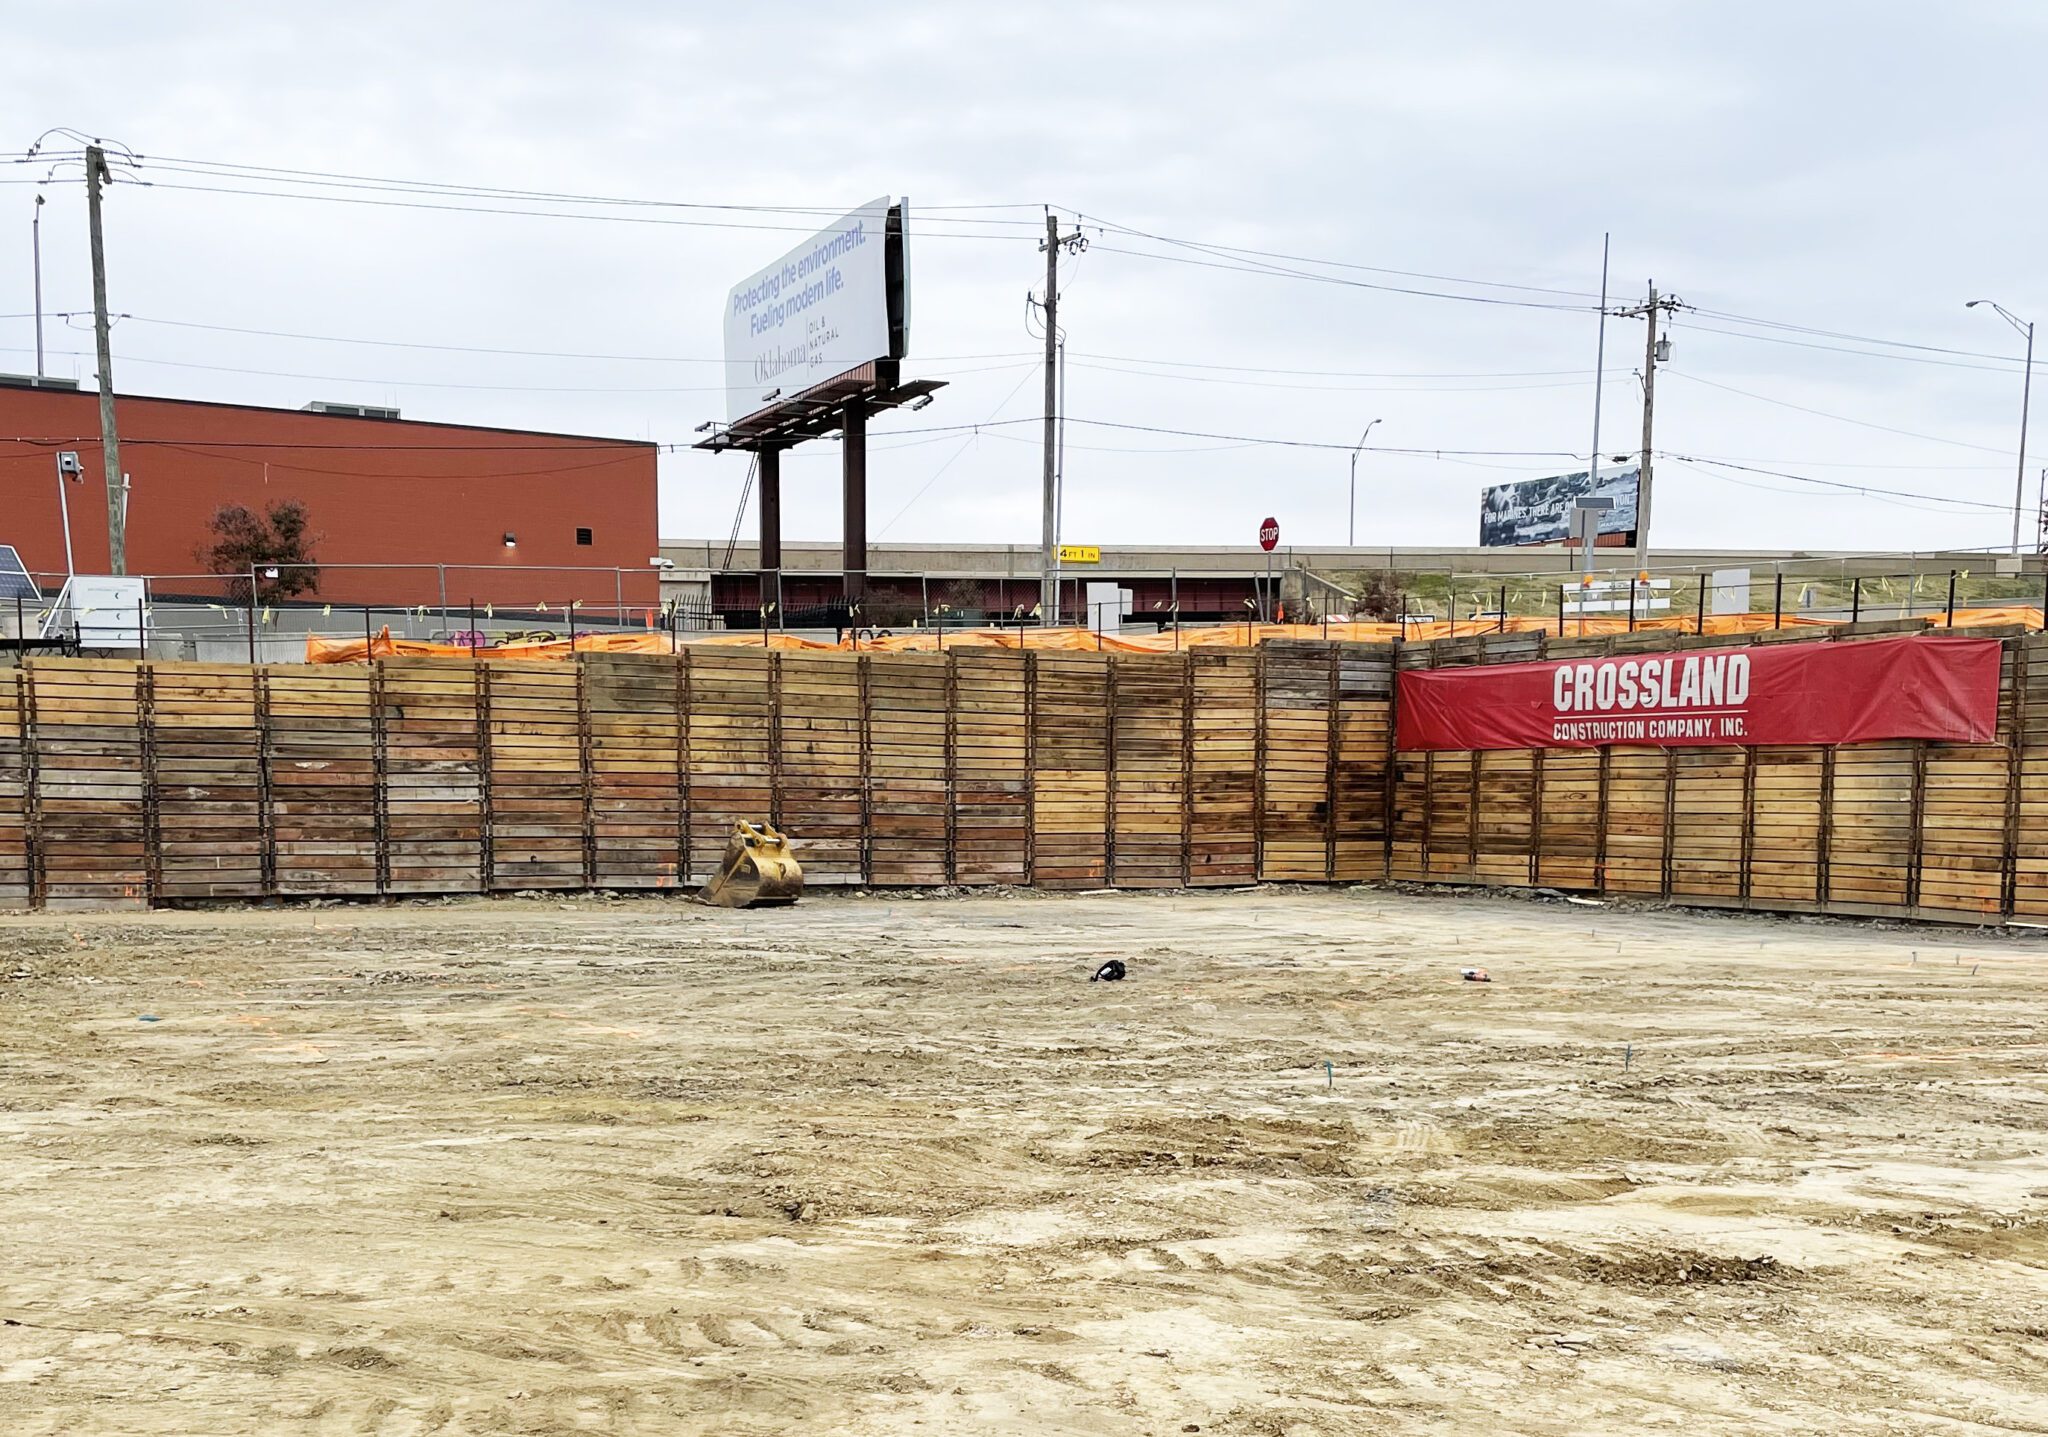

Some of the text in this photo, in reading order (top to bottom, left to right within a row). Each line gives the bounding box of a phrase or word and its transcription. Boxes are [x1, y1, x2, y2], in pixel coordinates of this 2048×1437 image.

[734, 219, 866, 317] Protecting the environment.
[750, 266, 844, 338] Fueling modern life.
[809, 320, 820, 334] OIL
[809, 327, 839, 351] NATURAL
[754, 344, 806, 385] Oklahoma
[810, 352, 823, 369] GAS
[1484, 511, 1497, 524] FOR
[1551, 501, 1564, 515] ARE
[1260, 527, 1279, 542] STOP
[1059, 549, 1067, 558] 4
[1553, 654, 1750, 712] CROSSLAND
[1553, 717, 1748, 741] CONSTRUCTION COMPANY, INC.
